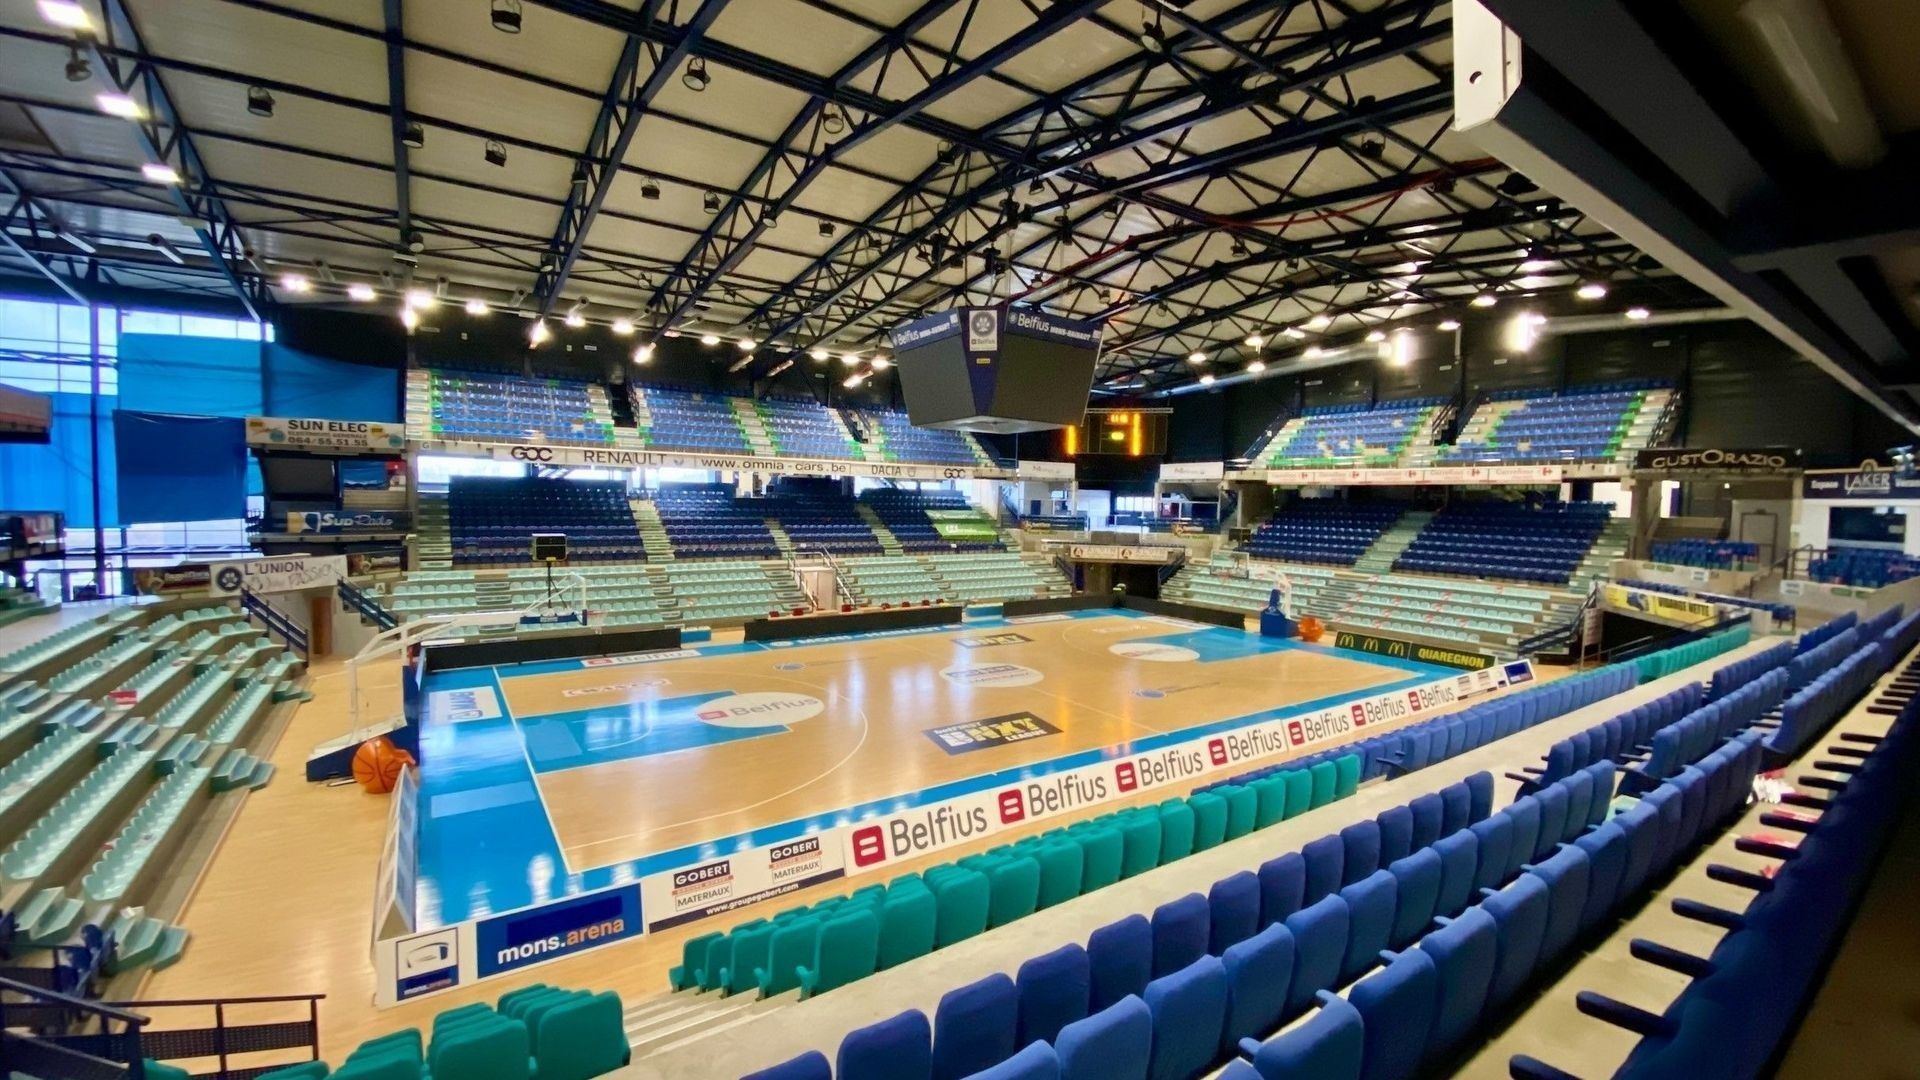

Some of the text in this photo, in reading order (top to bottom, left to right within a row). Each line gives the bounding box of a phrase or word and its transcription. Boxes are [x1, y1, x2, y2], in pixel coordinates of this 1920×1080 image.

[1017, 312, 1050, 332] Belfius
[897, 329, 919, 346] Belfius
[288, 419, 368, 433] SUN ELEC
[583, 450, 667, 465] RENAULT
[871, 464, 901, 476] DACIA
[244, 560, 304, 575] L'UNION
[616, 649, 694, 664] Belfius
[1418, 647, 1485, 668] QUAREGNON
[732, 697, 818, 716] Belfius
[1419, 683, 1454, 708] Belfius
[1364, 696, 1406, 723] Belfius
[1303, 711, 1349, 741] Belfius
[1227, 729, 1282, 761] Belfius
[1138, 749, 1203, 786] Belfius
[1027, 773, 1107, 817] Belfius
[890, 805, 987, 857] Belfius
[771, 839, 817, 860] GOBERT
[675, 863, 729, 885] GOBERT
[774, 861, 820, 880] MATERIAUX
[677, 885, 730, 907] MATERIAUX
[706, 883, 799, 915] www.groupegobert.com
[497, 917, 625, 965] mons.arena
